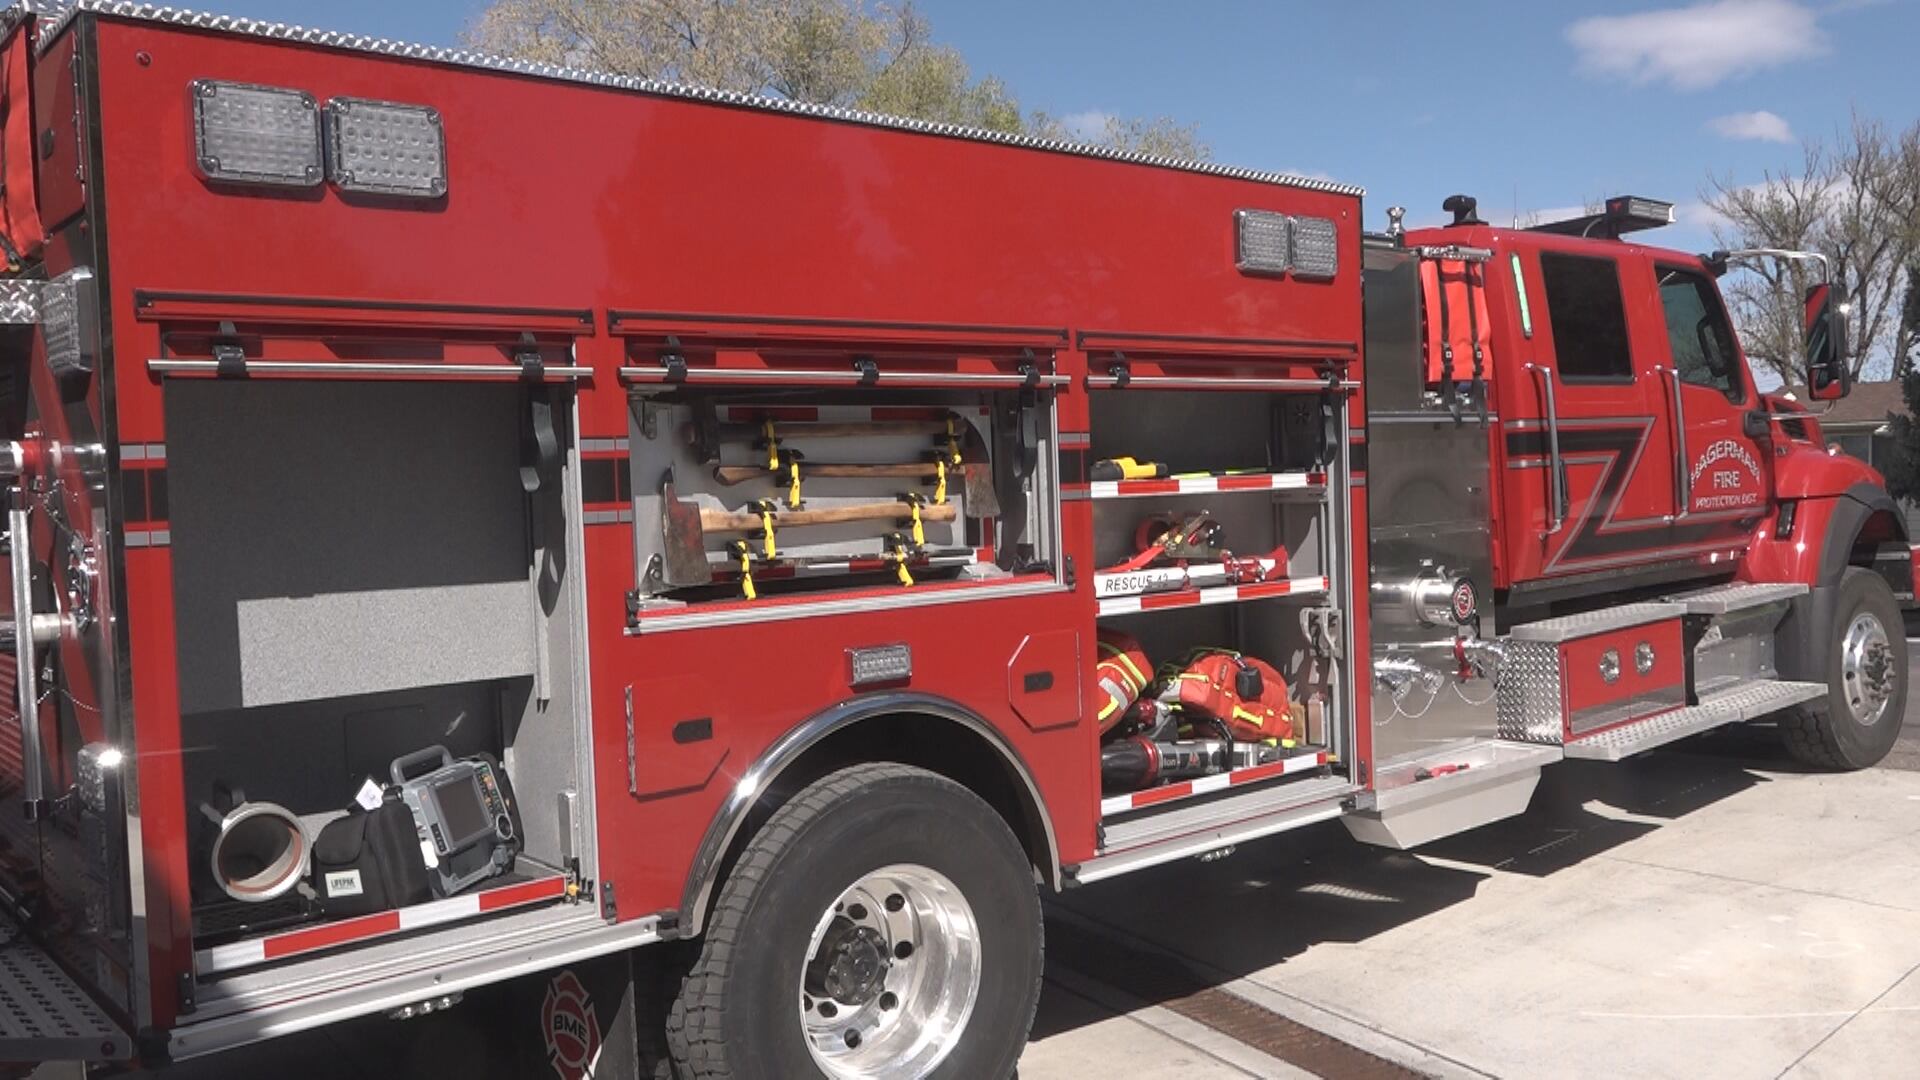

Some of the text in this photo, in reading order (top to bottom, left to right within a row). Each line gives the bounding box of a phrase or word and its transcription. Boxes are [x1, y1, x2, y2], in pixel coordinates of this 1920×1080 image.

[1690, 440, 1761, 488] HAGERMAN
[1713, 471, 1741, 489] FIRE
[1695, 495, 1741, 509] PROTECTION
[1105, 575, 1153, 592] RESCUE
[554, 1014, 588, 1044] BME
